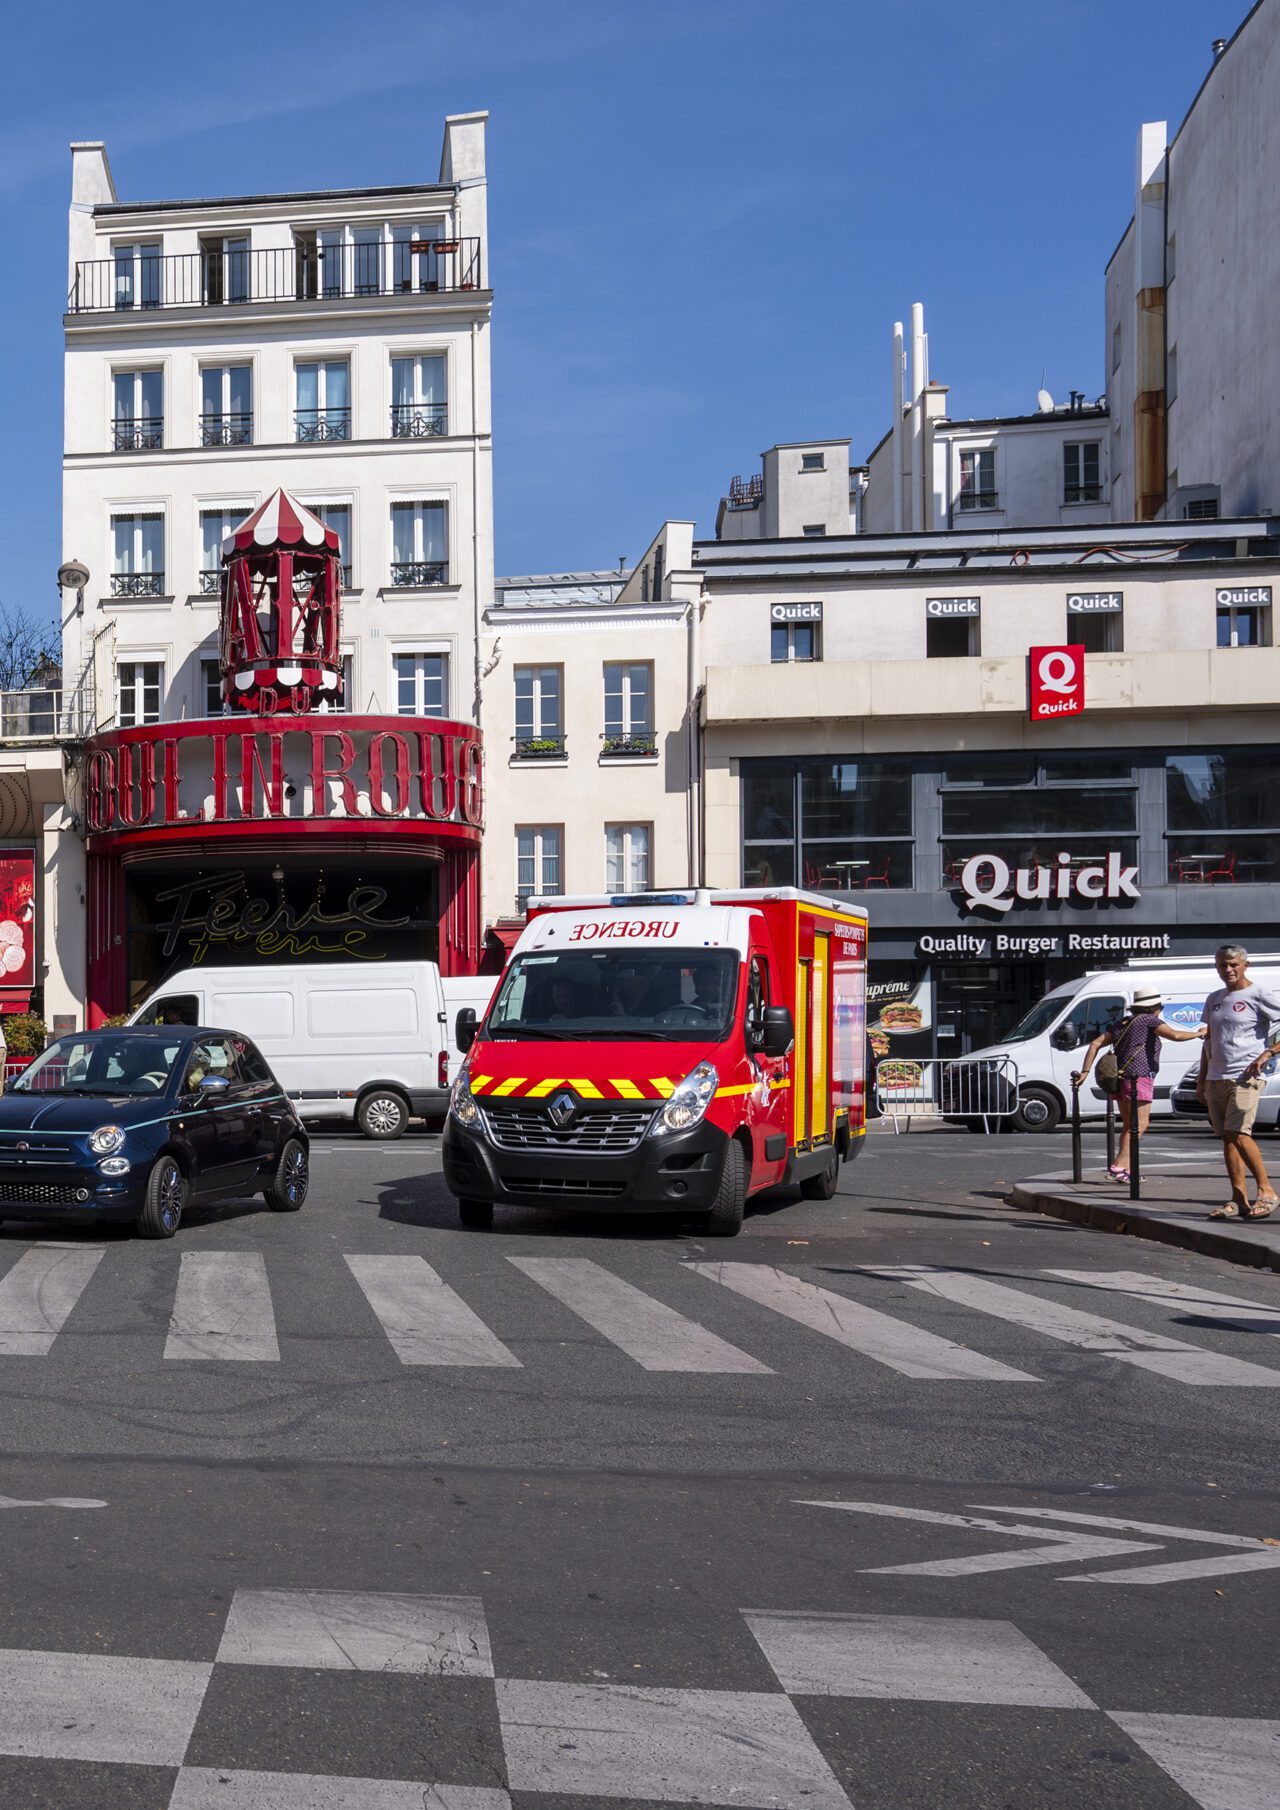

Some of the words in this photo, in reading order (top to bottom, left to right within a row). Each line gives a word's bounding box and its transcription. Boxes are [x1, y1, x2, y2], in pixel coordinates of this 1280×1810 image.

[1069, 594, 1119, 611] Quick
[1218, 588, 1269, 606] Quick
[772, 604, 820, 620] Quick
[928, 599, 977, 616] Quick
[1038, 651, 1077, 694] Q
[259, 687, 310, 715] DU
[1038, 699, 1078, 715] Quick
[87, 732, 286, 832] OULIN
[310, 730, 484, 826] ROUG
[961, 851, 1142, 912] Quick
[919, 935, 986, 954] Quality
[996, 934, 1059, 953] Burger
[1069, 933, 1171, 950] Restaurant
[866, 980, 911, 999] uprême
